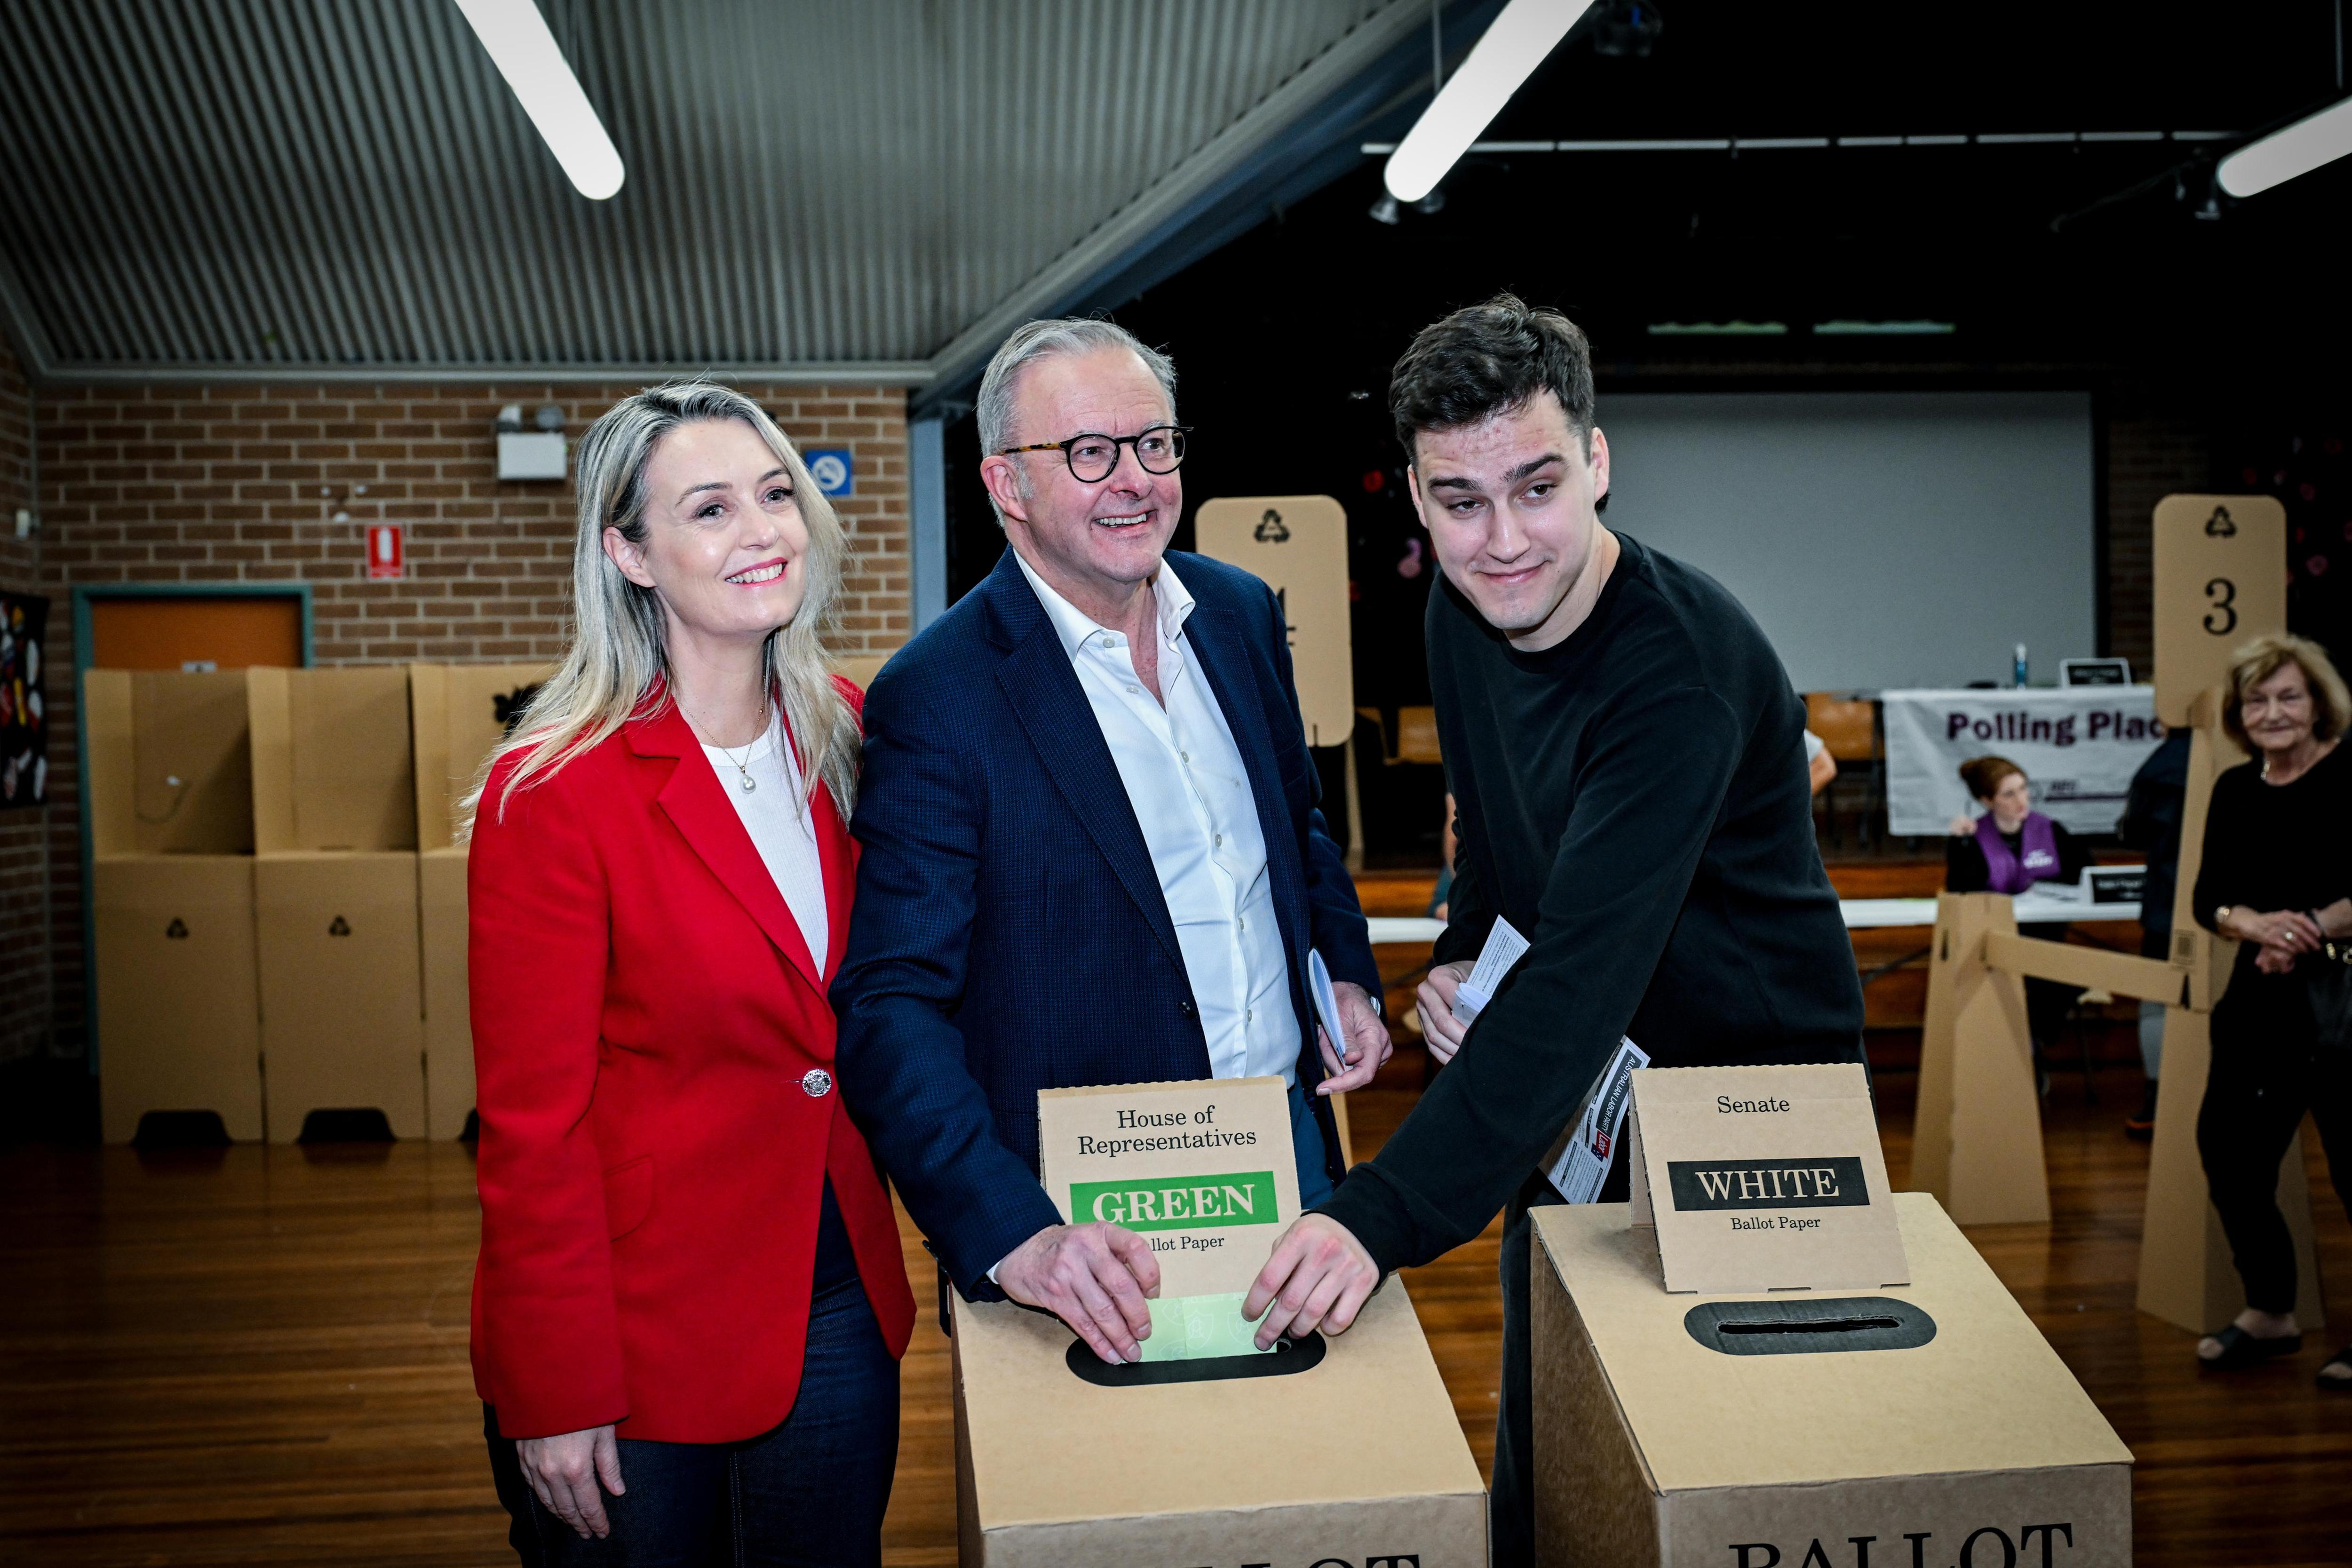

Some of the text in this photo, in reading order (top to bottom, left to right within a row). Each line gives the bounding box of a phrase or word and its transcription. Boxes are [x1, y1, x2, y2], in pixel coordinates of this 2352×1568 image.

[2203, 578, 2238, 636] 3
[1946, 710, 2165, 747] Polling Plac
[1613, 1056, 1636, 1098] AUSTRALIAN
[1116, 1105, 1216, 1129] House of
[1605, 1095, 1617, 1115] LABOR
[1717, 1096, 1790, 1114] Senate
[1601, 1114, 1611, 1133] PARTY
[1077, 1129, 1256, 1158] Representatives
[1598, 1134, 1608, 1153] Labor
[1695, 1168, 1840, 1201] WHITE
[1092, 1184, 1255, 1223] GREEN
[1730, 1216, 1821, 1231] Ballot Paper
[1150, 1236, 1225, 1251] llot Paper
